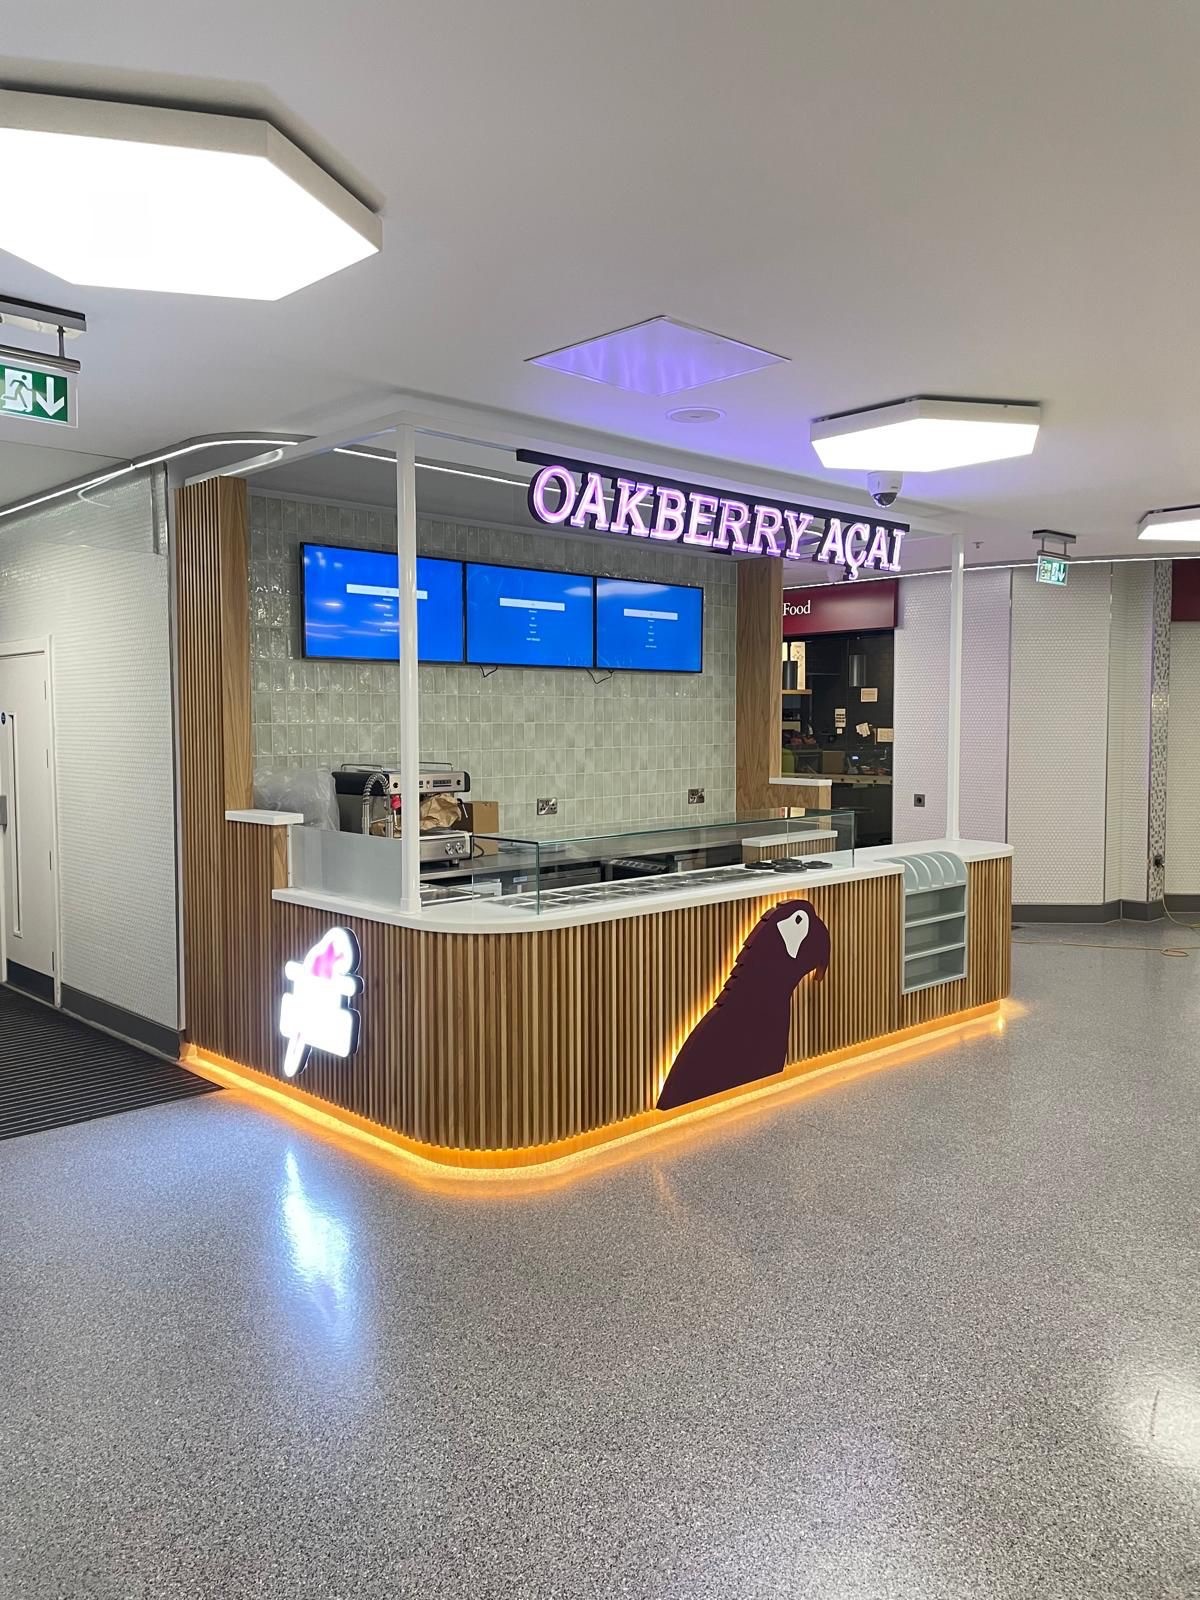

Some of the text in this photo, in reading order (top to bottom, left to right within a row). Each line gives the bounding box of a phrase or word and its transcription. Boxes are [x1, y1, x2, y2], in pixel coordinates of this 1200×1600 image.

[530, 464, 907, 580] OAKBERRY AÇAI
[783, 599, 811, 616] Food
